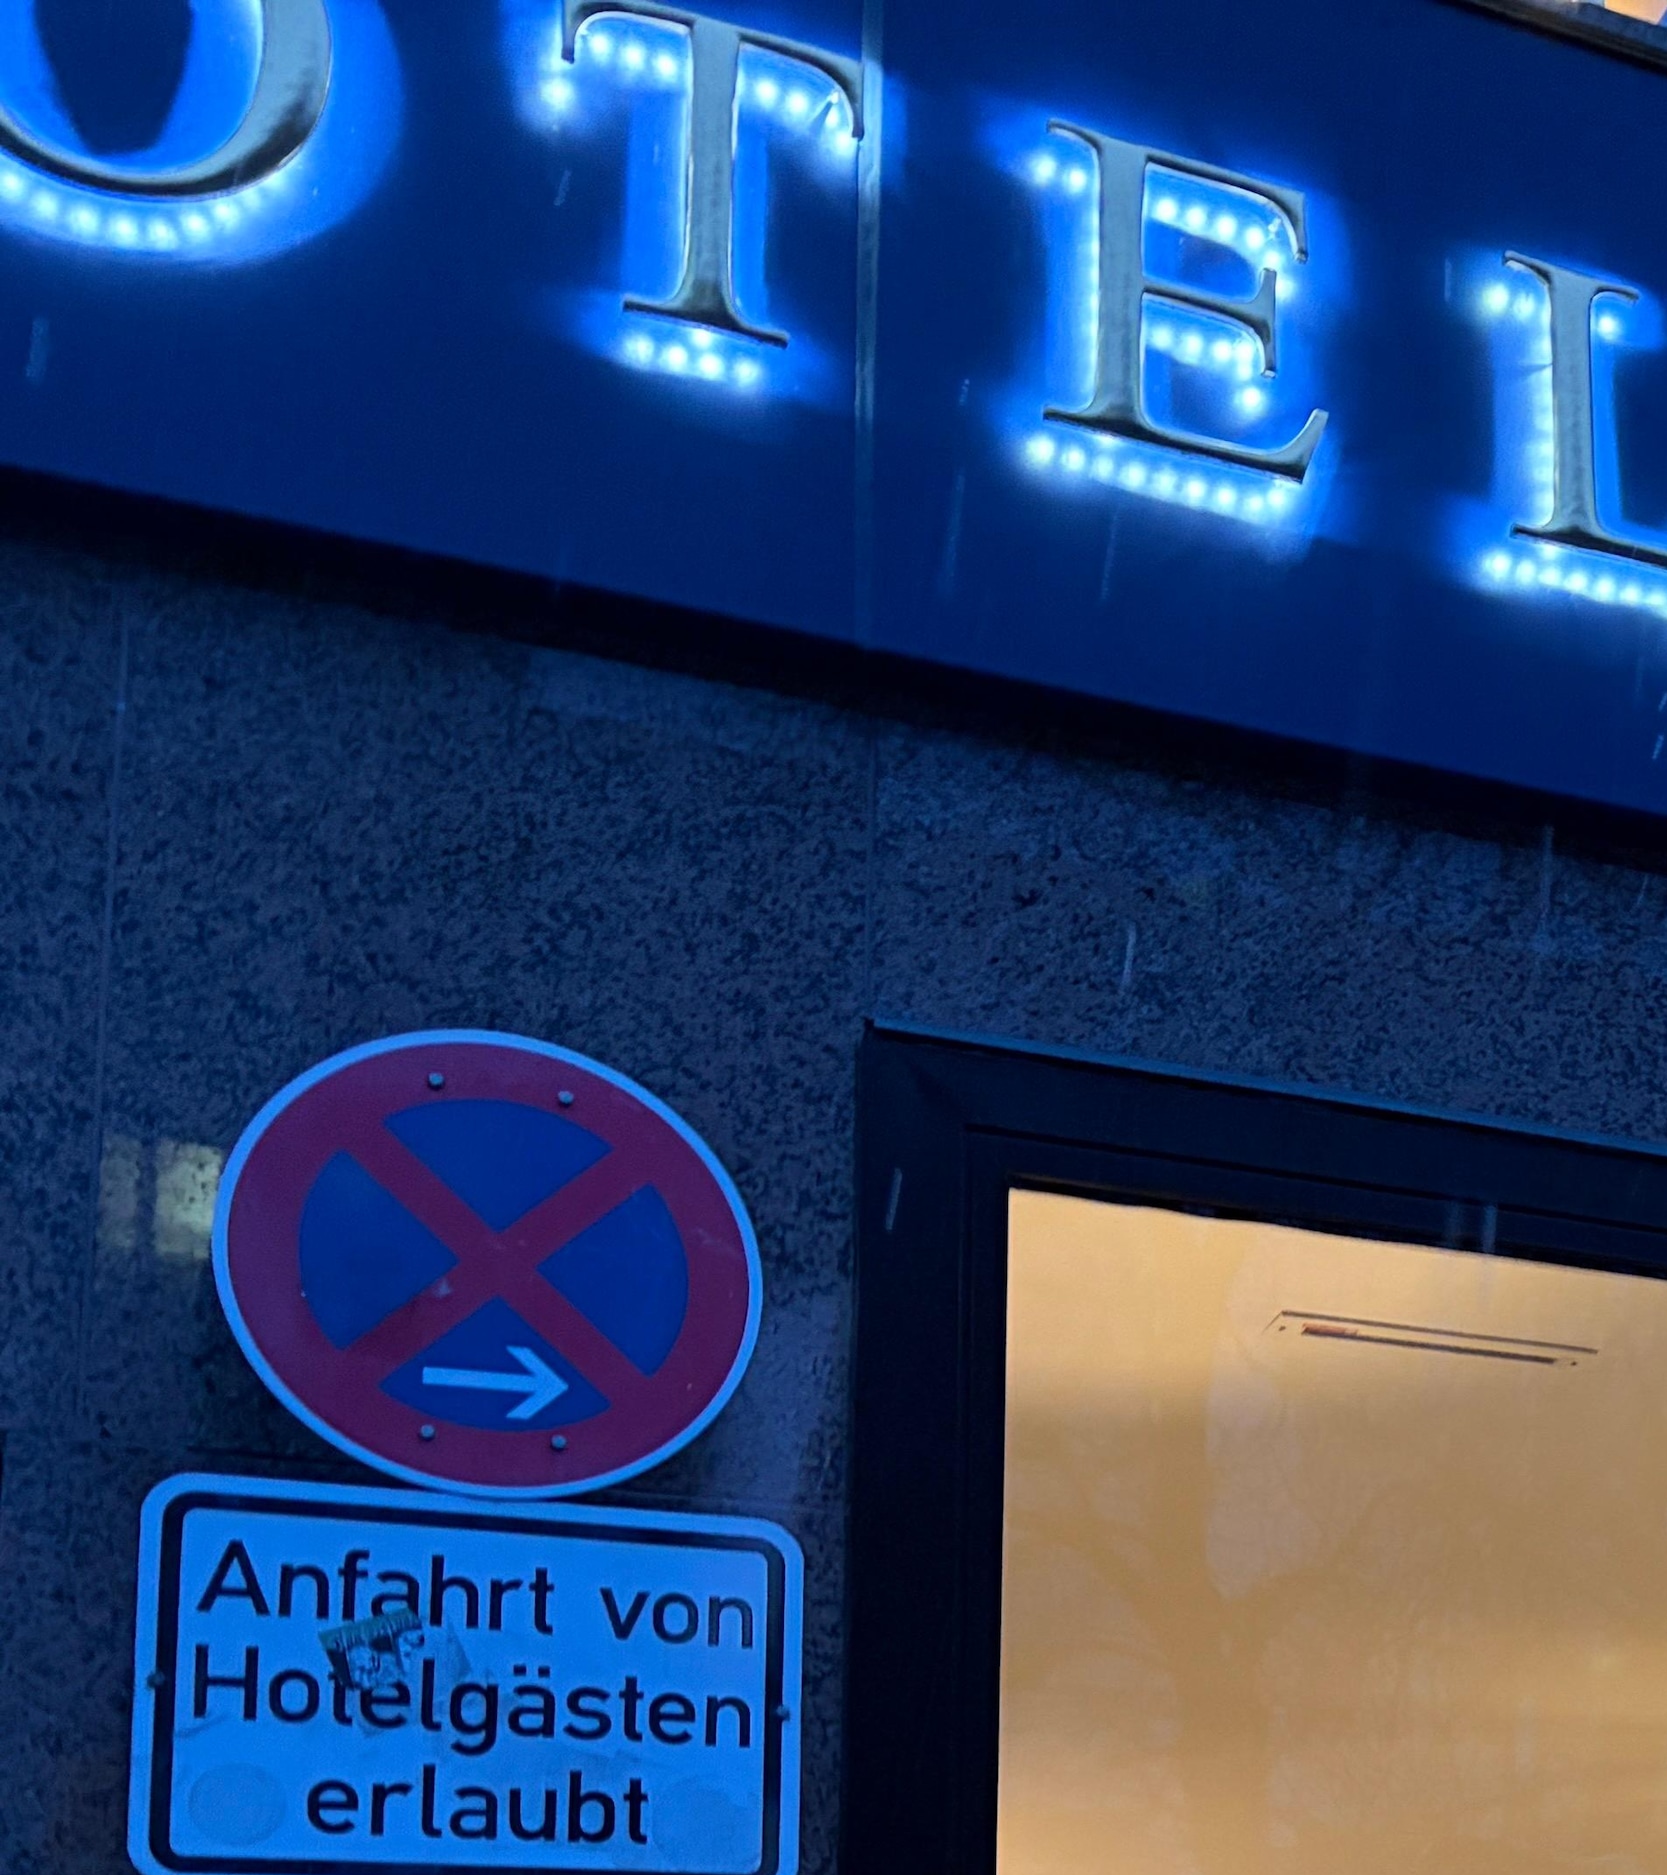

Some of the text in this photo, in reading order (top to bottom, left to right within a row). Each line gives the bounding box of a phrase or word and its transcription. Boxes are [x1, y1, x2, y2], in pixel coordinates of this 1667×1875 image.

[194, 1538, 754, 1650] Anfahrt von
[191, 1644, 753, 1756] Hotelgästen
[304, 1766, 650, 1846] erlaubt
